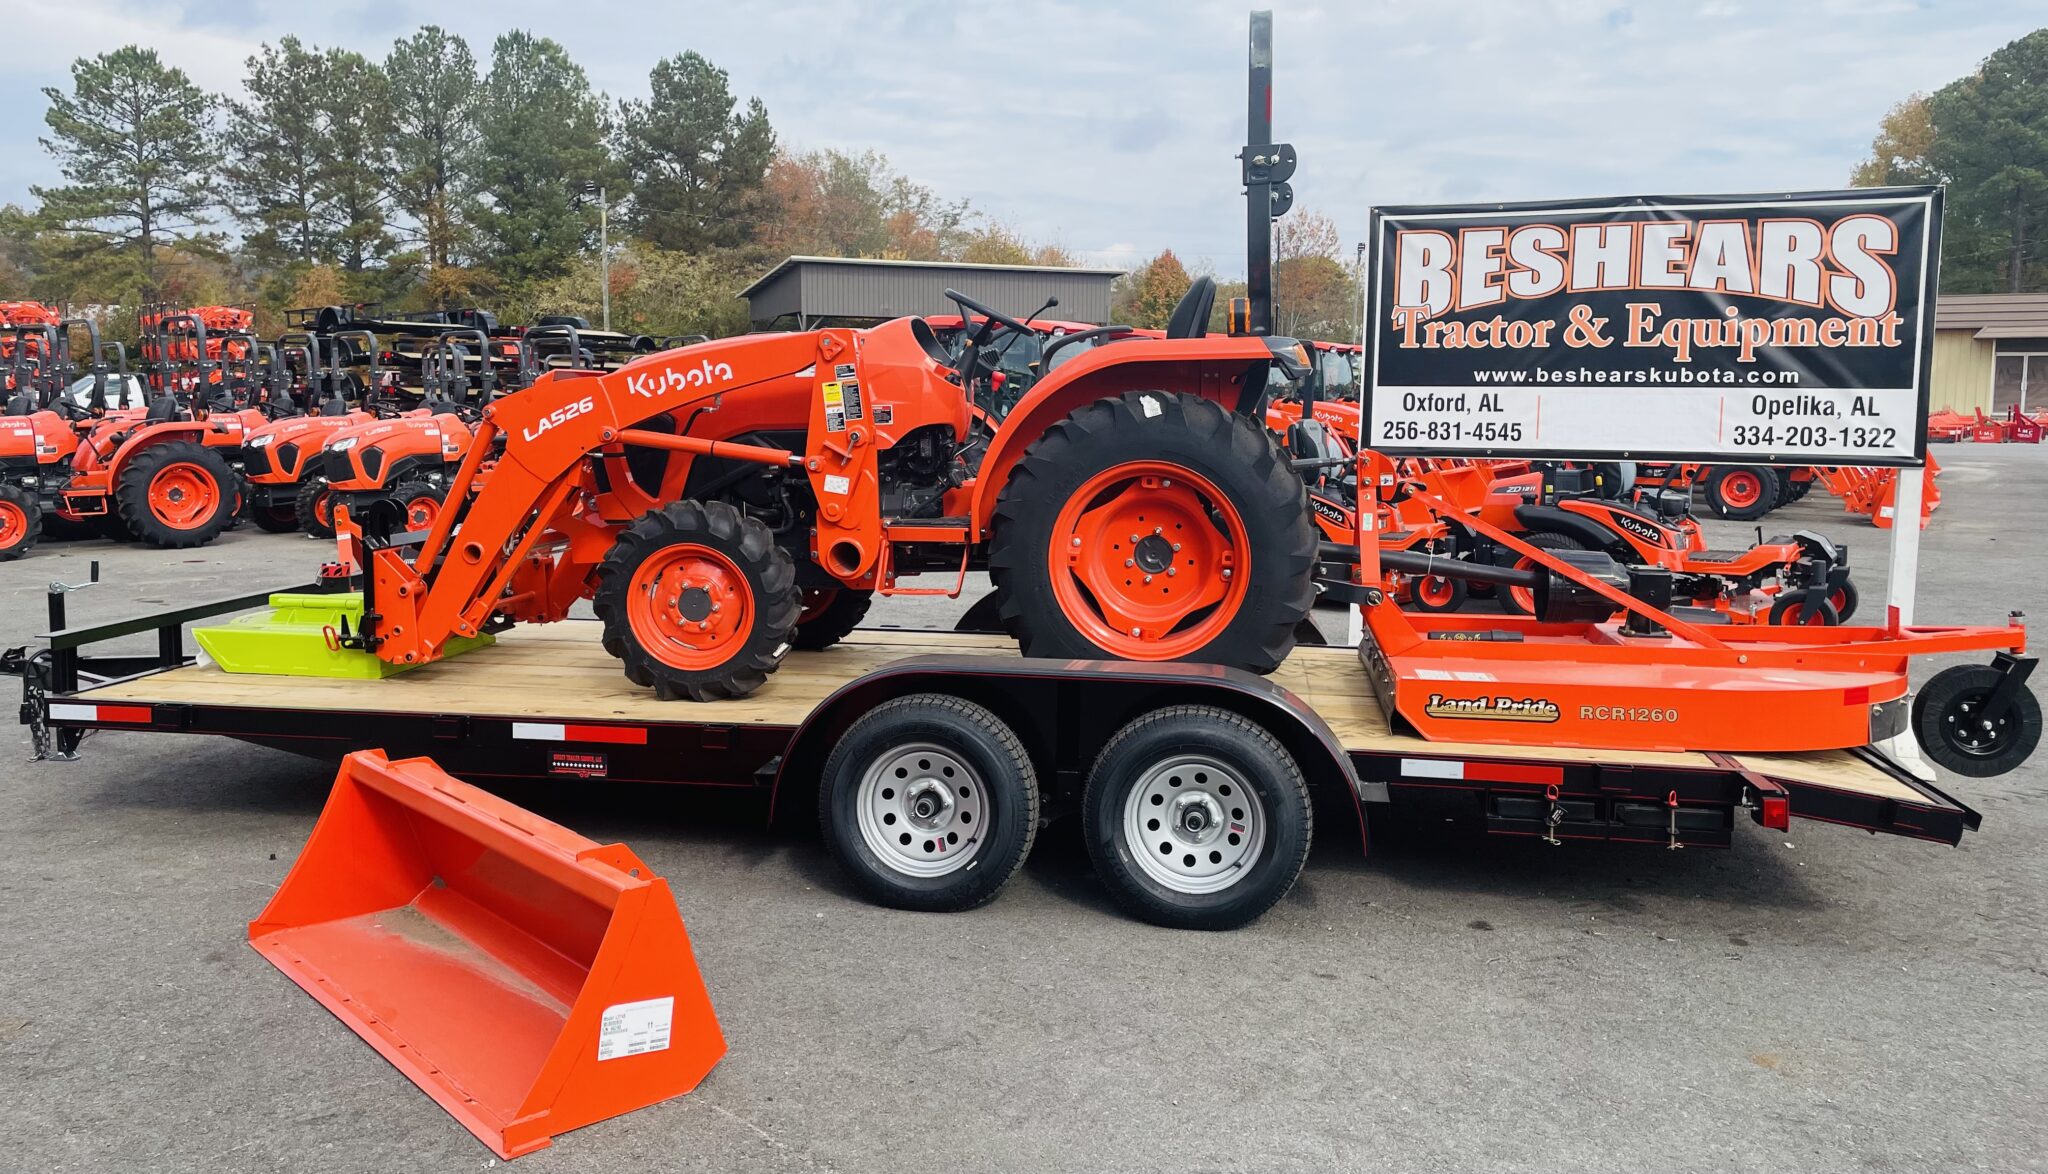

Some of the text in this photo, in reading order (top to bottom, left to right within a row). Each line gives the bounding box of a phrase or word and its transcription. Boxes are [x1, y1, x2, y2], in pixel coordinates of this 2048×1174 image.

[1393, 214, 1898, 331] BESHEARS
[1391, 303, 1904, 362] Tractor & Equipment
[627, 359, 733, 398] Kubota
[1473, 367, 1800, 384] www.beshearskubota.com
[1402, 392, 1504, 415] Oxford, AL
[1752, 394, 1880, 420] Opelika, AL
[522, 396, 594, 442] LA526
[1314, 411, 1343, 423] Kubota
[1383, 420, 1522, 441] 256-831-4545
[1733, 425, 1896, 448] 334-203-1322
[1312, 500, 1343, 522] Kubota
[1620, 516, 1659, 541] Kubota
[1429, 695, 1558, 716] Land Pride
[1579, 705, 1678, 723] RCR1260
